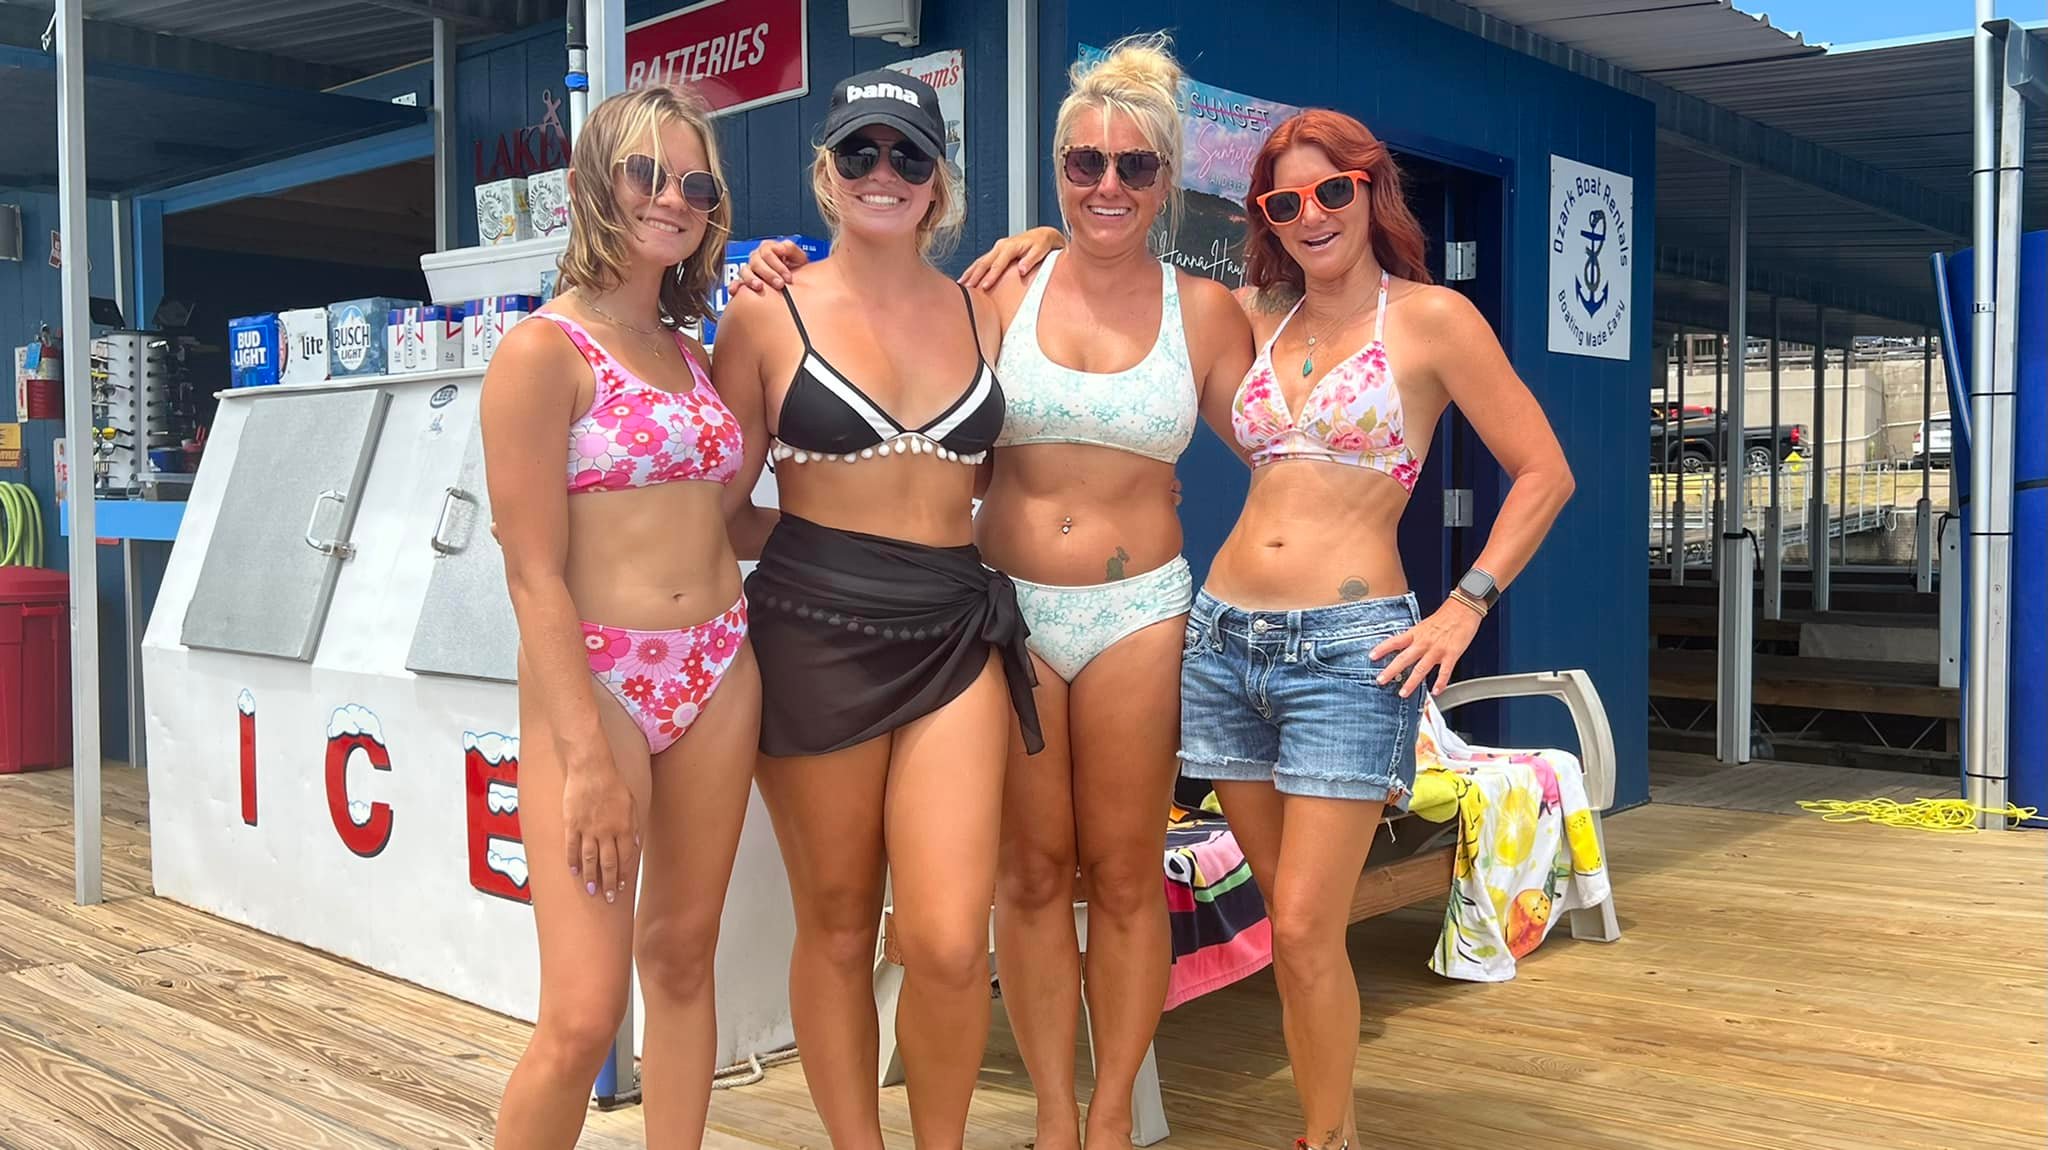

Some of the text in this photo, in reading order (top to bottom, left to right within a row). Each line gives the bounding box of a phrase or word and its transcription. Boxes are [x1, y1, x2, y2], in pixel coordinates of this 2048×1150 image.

[628, 23, 769, 90] BATTERIES
[847, 83, 920, 108] bama
[1190, 91, 1271, 131] SUNSET
[1553, 176, 1629, 267] Ozark Boat Rentals
[1558, 289, 1626, 347] Boating Made Easy
[237, 330, 261, 348] BUD
[300, 335, 324, 361] Lite
[334, 324, 371, 349] BUSCH
[234, 347, 267, 367] LIGHT
[341, 347, 362, 360] LIGHT
[237, 687, 534, 905] ICE
